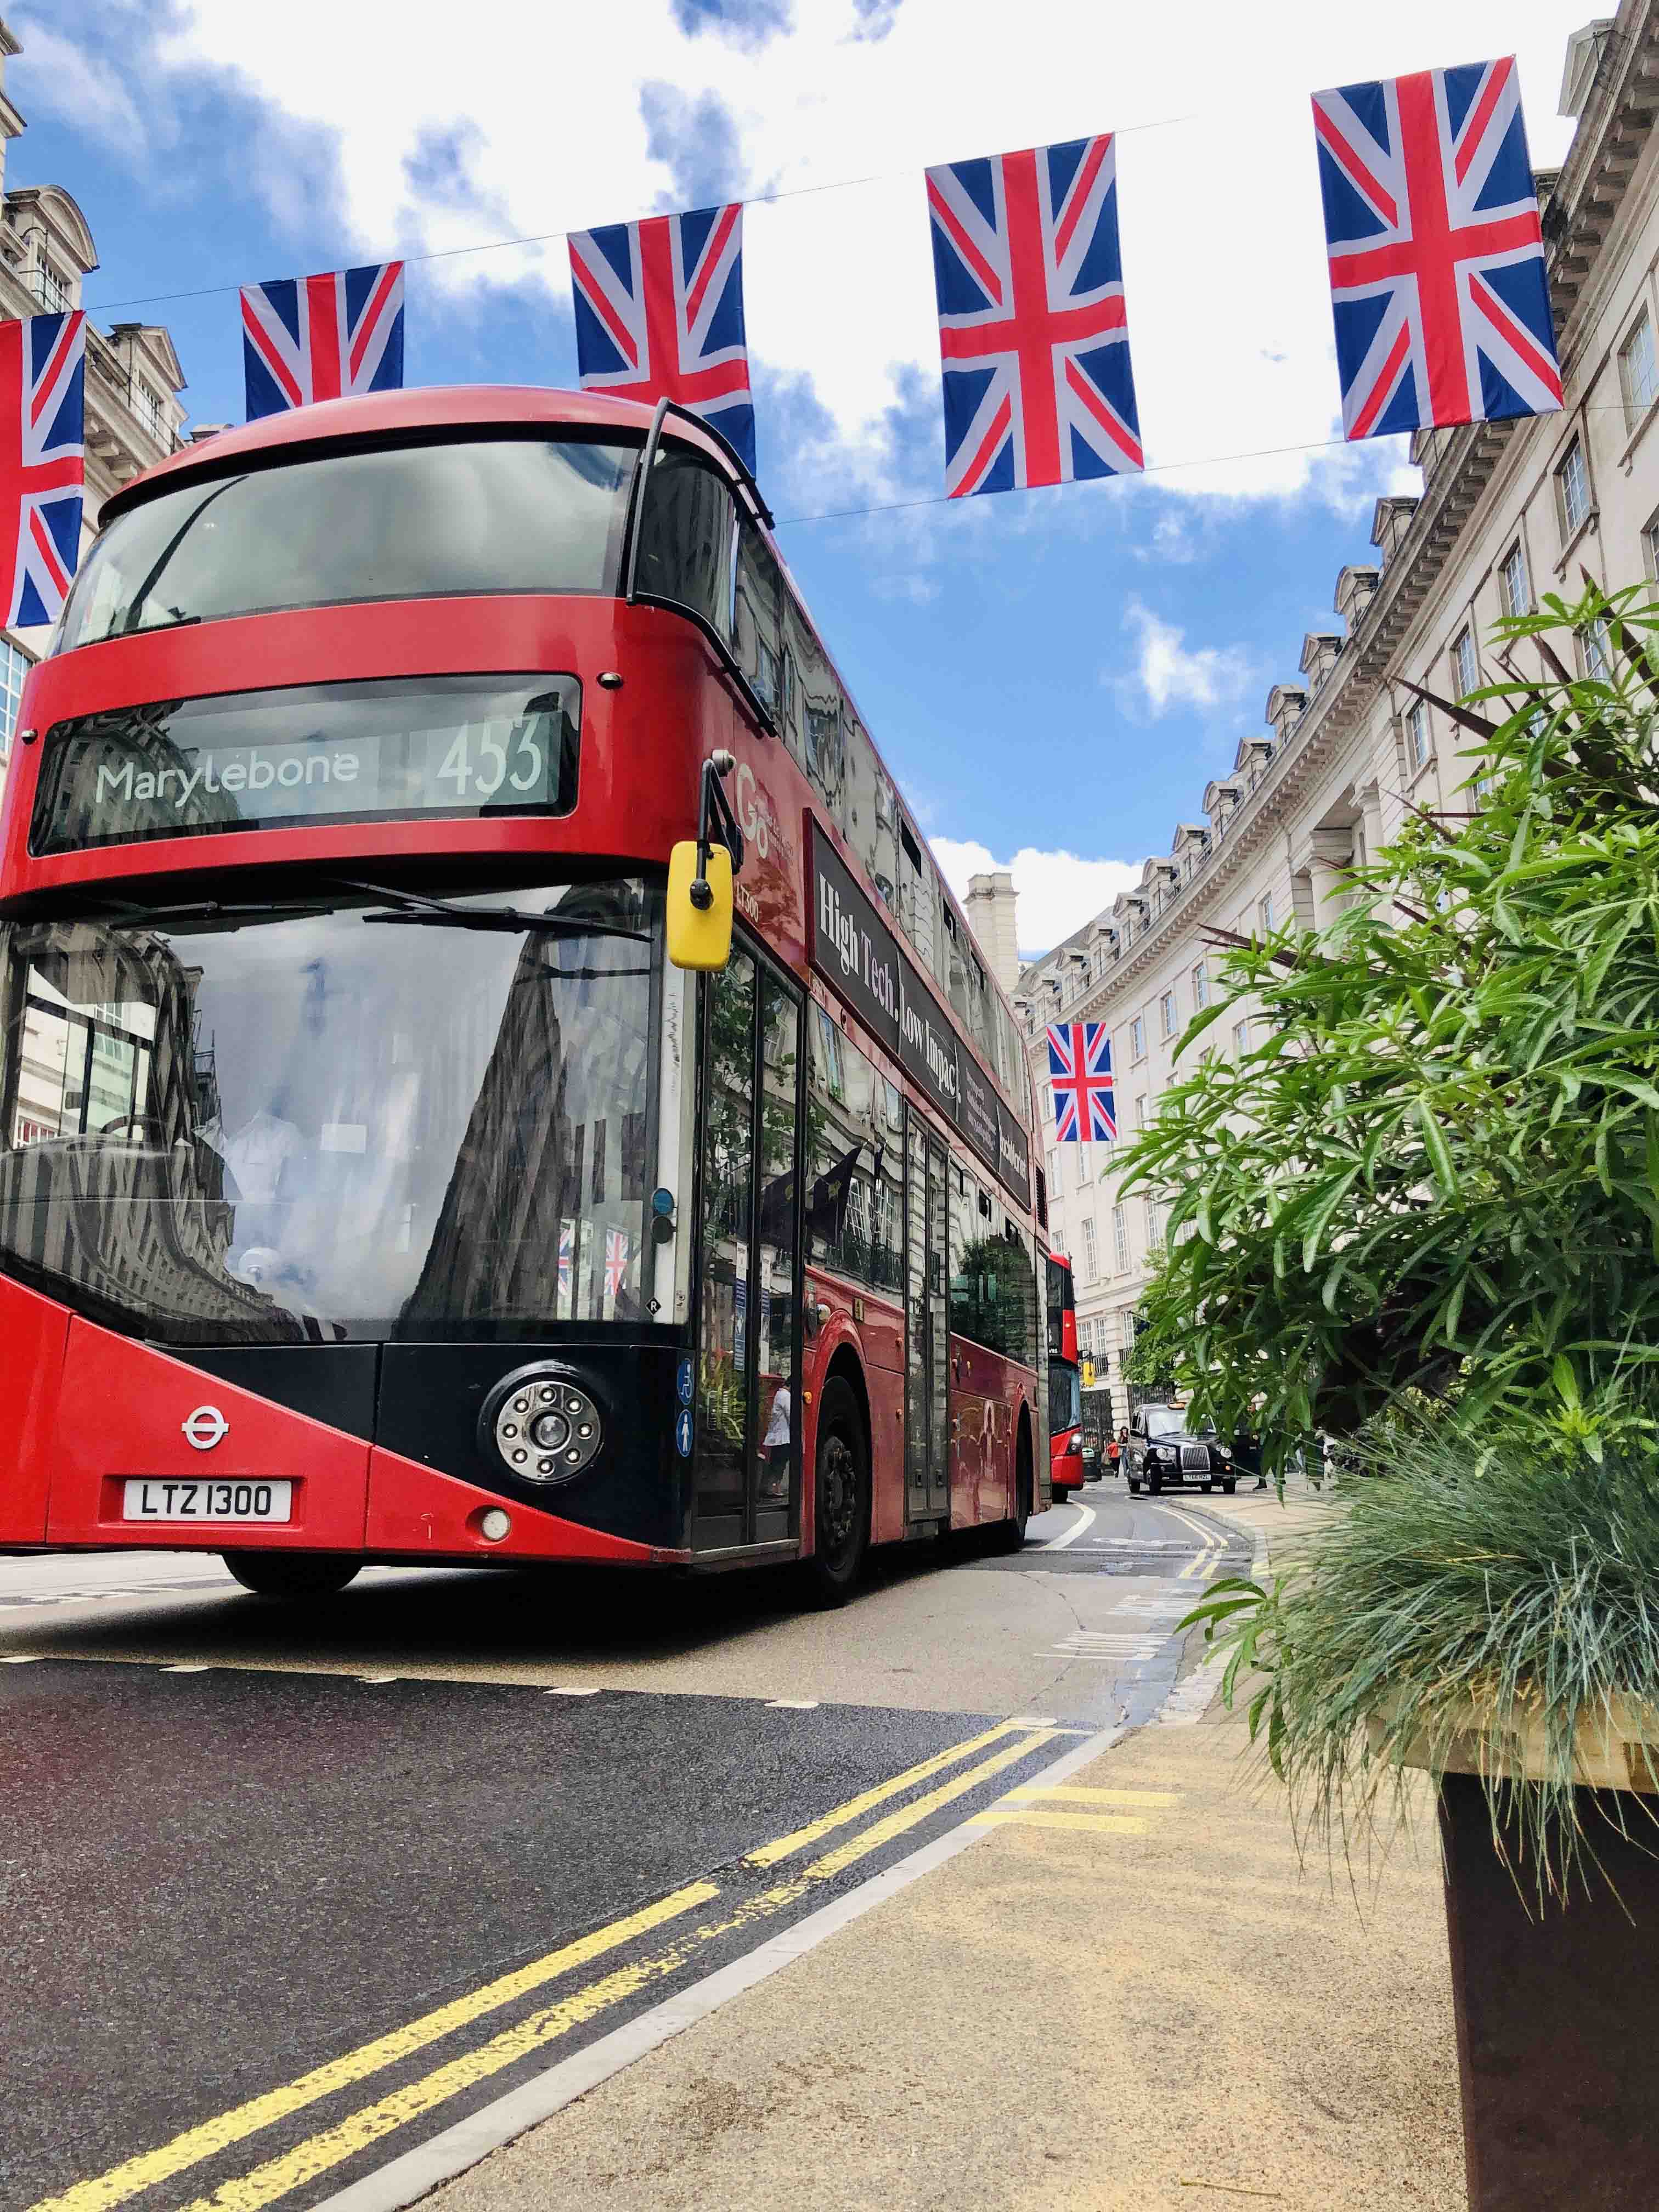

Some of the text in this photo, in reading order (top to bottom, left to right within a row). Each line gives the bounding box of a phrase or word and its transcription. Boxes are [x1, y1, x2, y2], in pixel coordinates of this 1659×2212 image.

[96, 714, 541, 808] Marylebone 453
[737, 763, 768, 859] Go
[737, 881, 759, 922] LT300
[819, 872, 859, 975] High
[861, 929, 899, 1022] Tech.
[899, 982, 924, 1054] Low
[141, 1484, 272, 1515] LTZ 1300
